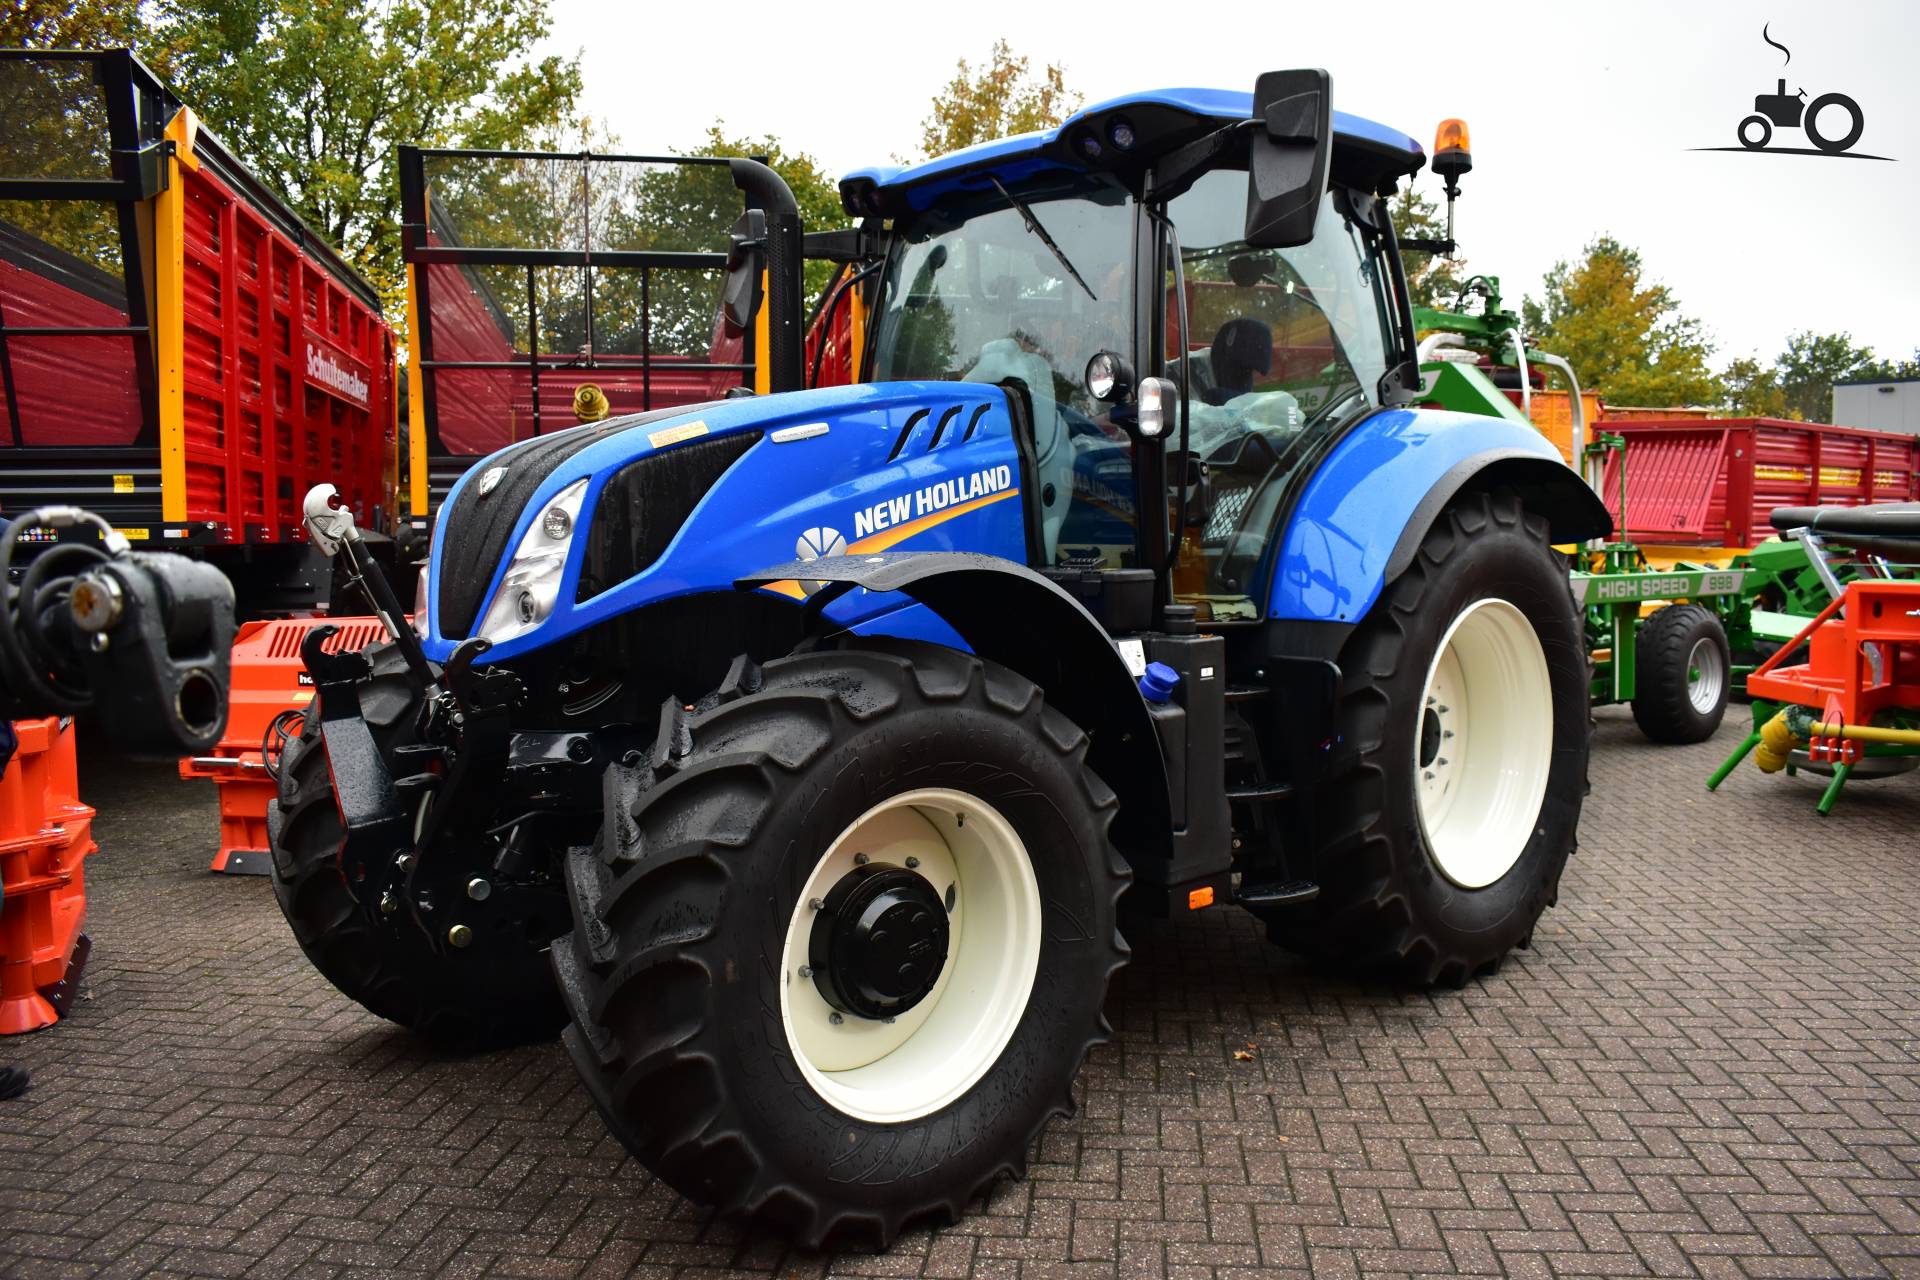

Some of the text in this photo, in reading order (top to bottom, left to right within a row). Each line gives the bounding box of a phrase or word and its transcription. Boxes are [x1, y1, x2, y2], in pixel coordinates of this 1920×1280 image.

[306, 343, 369, 403] Schuitemaker
[854, 492, 912, 538] NEW
[916, 464, 1011, 517] HOLLAND
[1598, 579, 1638, 599] HIGH
[1641, 577, 1690, 597] SPEED
